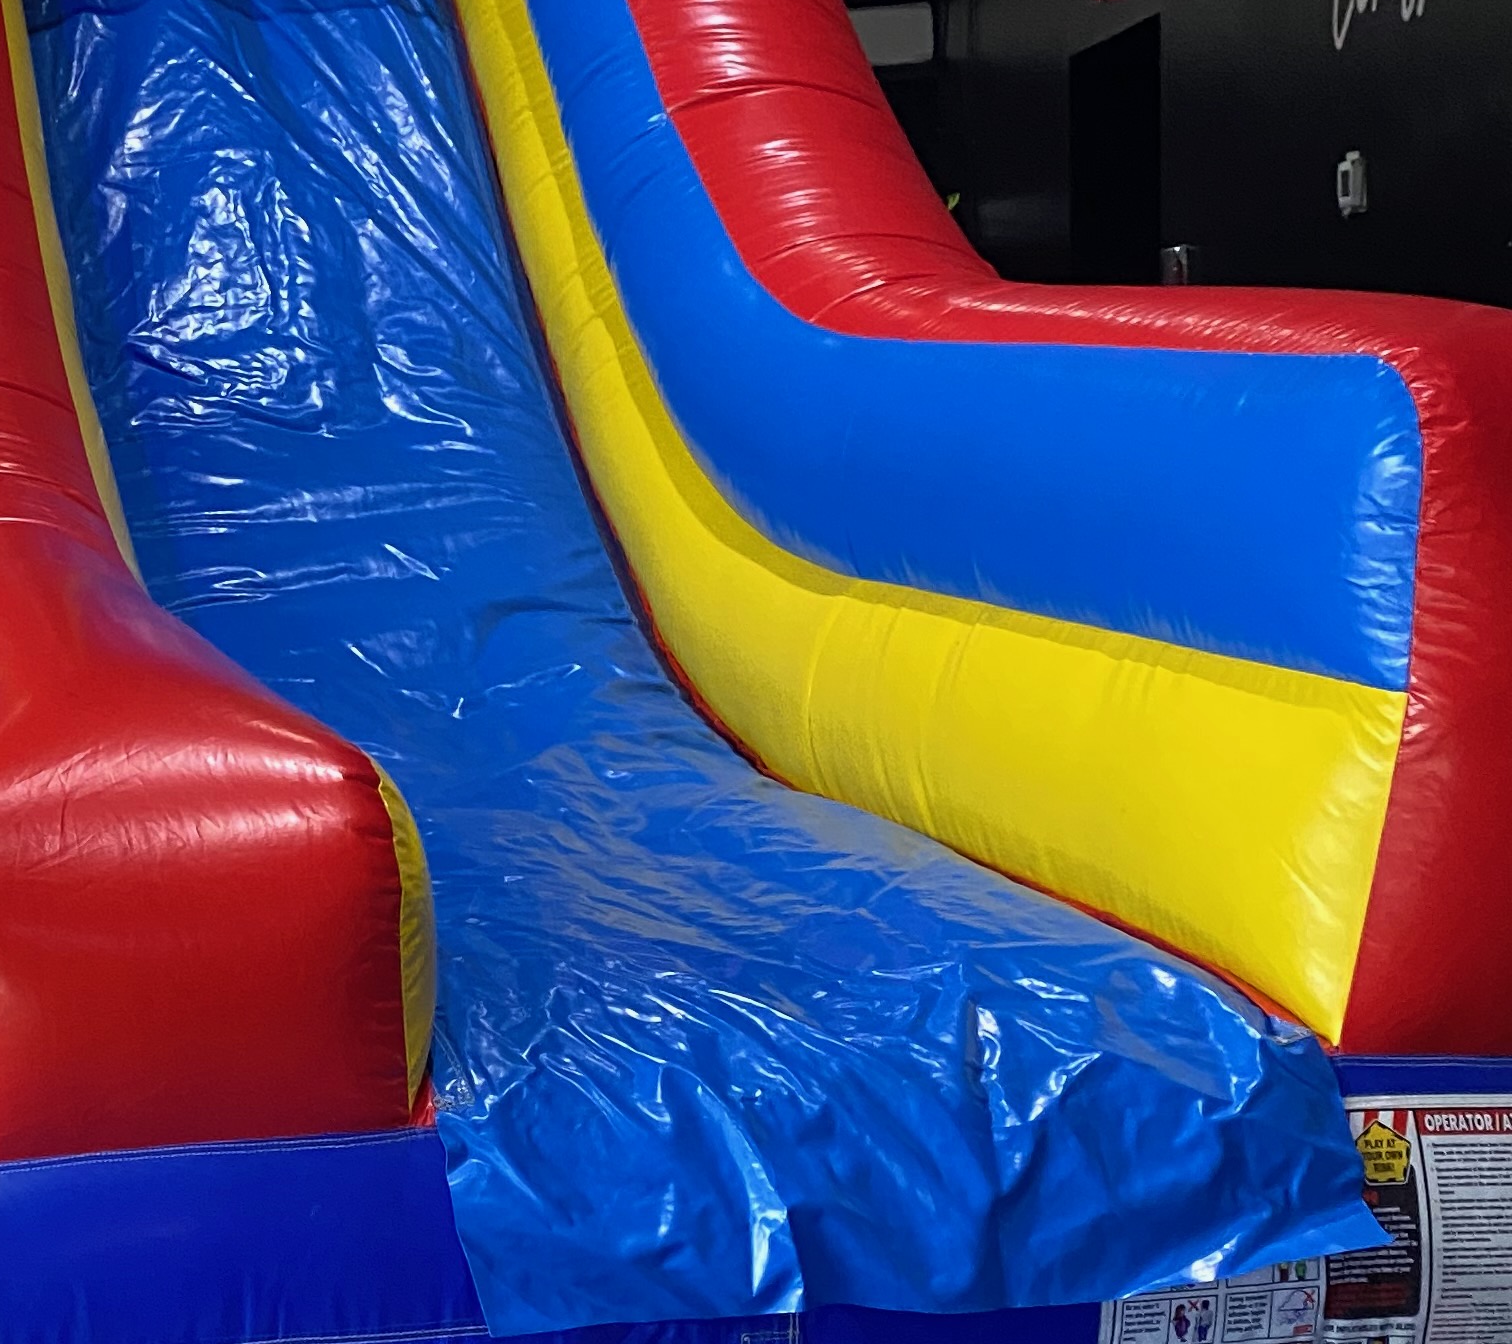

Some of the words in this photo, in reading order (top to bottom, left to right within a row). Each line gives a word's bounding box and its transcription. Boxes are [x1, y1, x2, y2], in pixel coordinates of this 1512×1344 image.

[1424, 1113, 1493, 1131] OPERATOR
[1364, 1138, 1383, 1149] PLAY
[1386, 1137, 1396, 1148] AT
